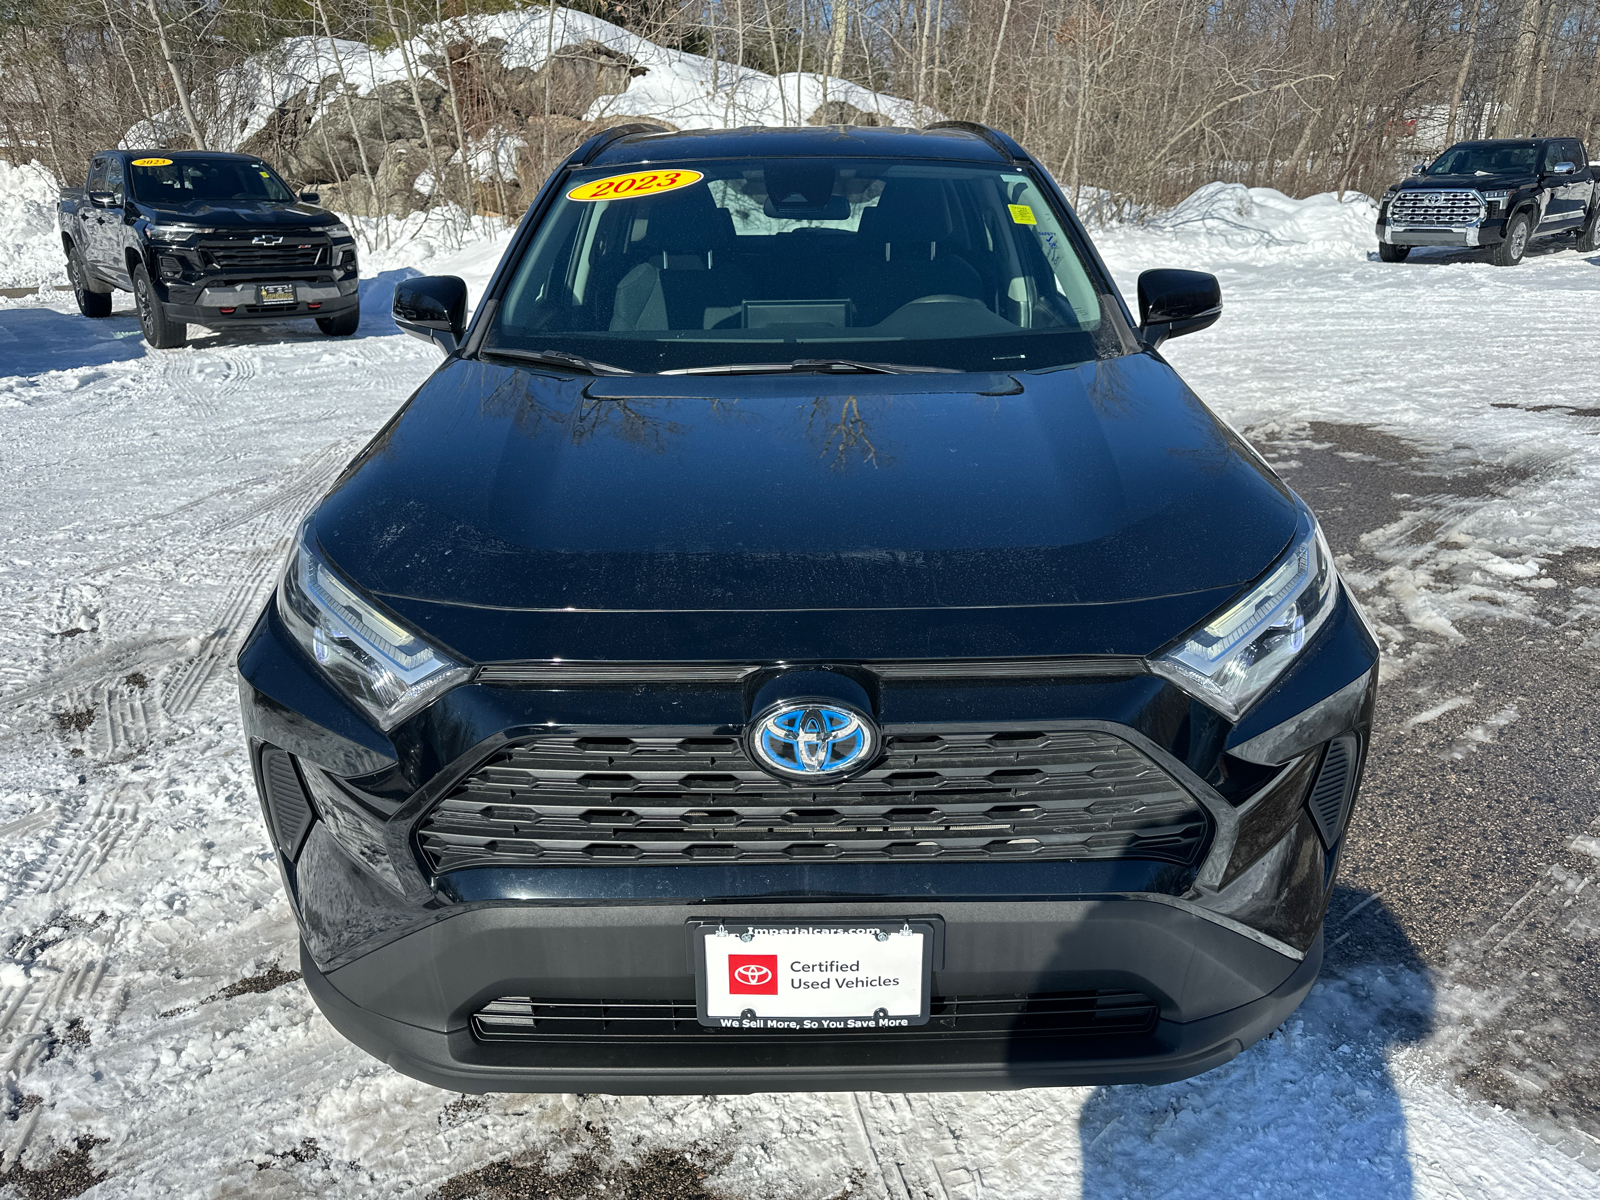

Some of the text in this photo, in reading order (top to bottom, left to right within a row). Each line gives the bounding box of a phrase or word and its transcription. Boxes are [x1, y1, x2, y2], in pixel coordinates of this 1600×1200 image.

[589, 172, 682, 198] 2023
[747, 926, 881, 936] Imperialcars.com
[790, 960, 860, 973] Certified
[791, 976, 900, 990] Used Vehicles
[720, 1017, 908, 1030] We Sell More, So You Save More
